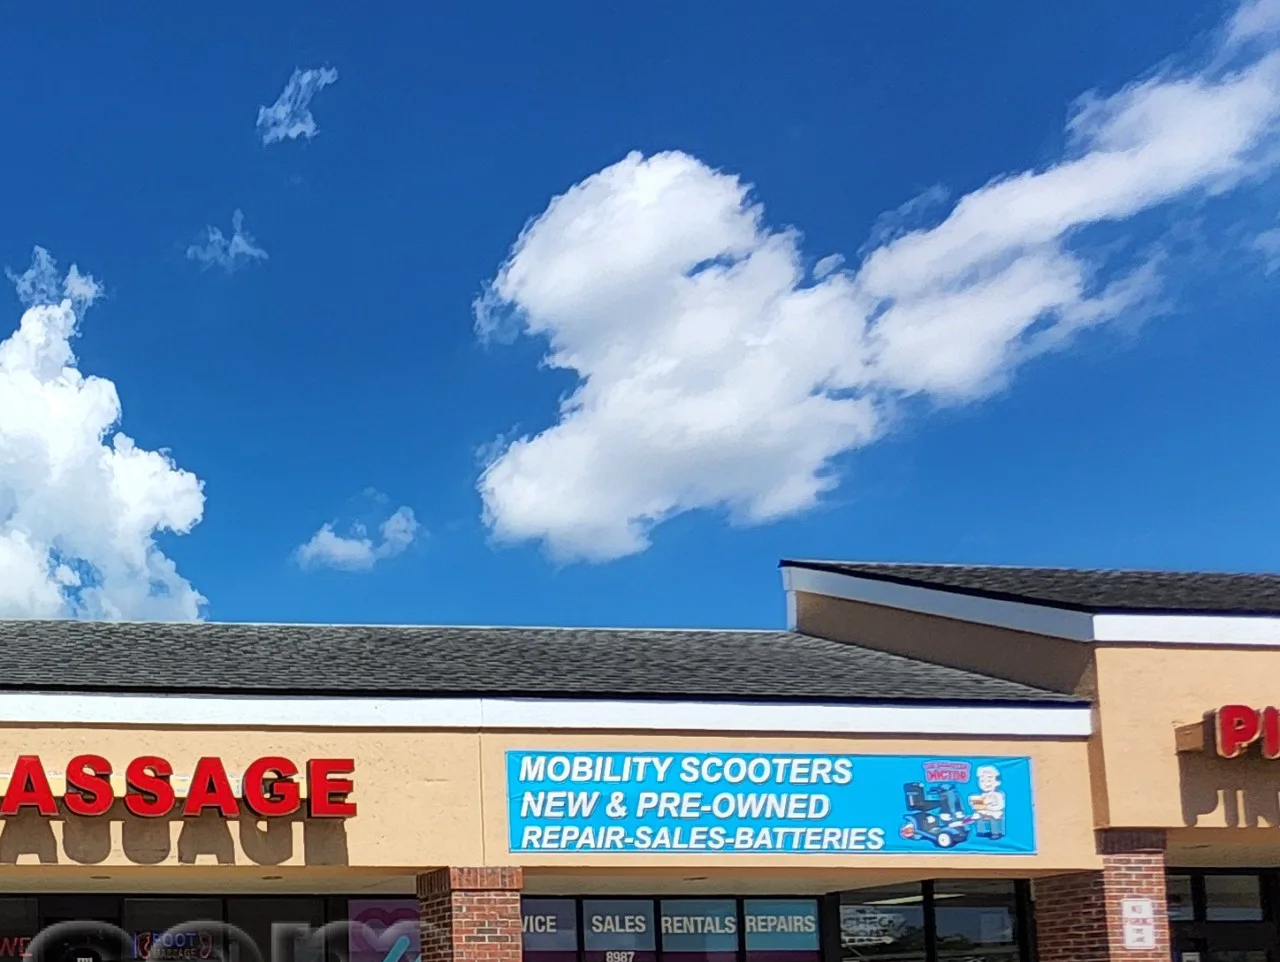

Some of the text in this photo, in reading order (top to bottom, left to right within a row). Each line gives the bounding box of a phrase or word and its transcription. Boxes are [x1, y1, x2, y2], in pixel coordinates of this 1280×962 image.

[520, 756, 854, 785] MOBILITY SCOOTERS
[520, 791, 832, 820] NEW & PRE-OWNED
[522, 825, 885, 850] REPAIR-SALES-BATTERIES
[591, 915, 646, 933] SALES
[662, 916, 736, 934] RENTALS
[746, 915, 816, 933] REPAIRS
